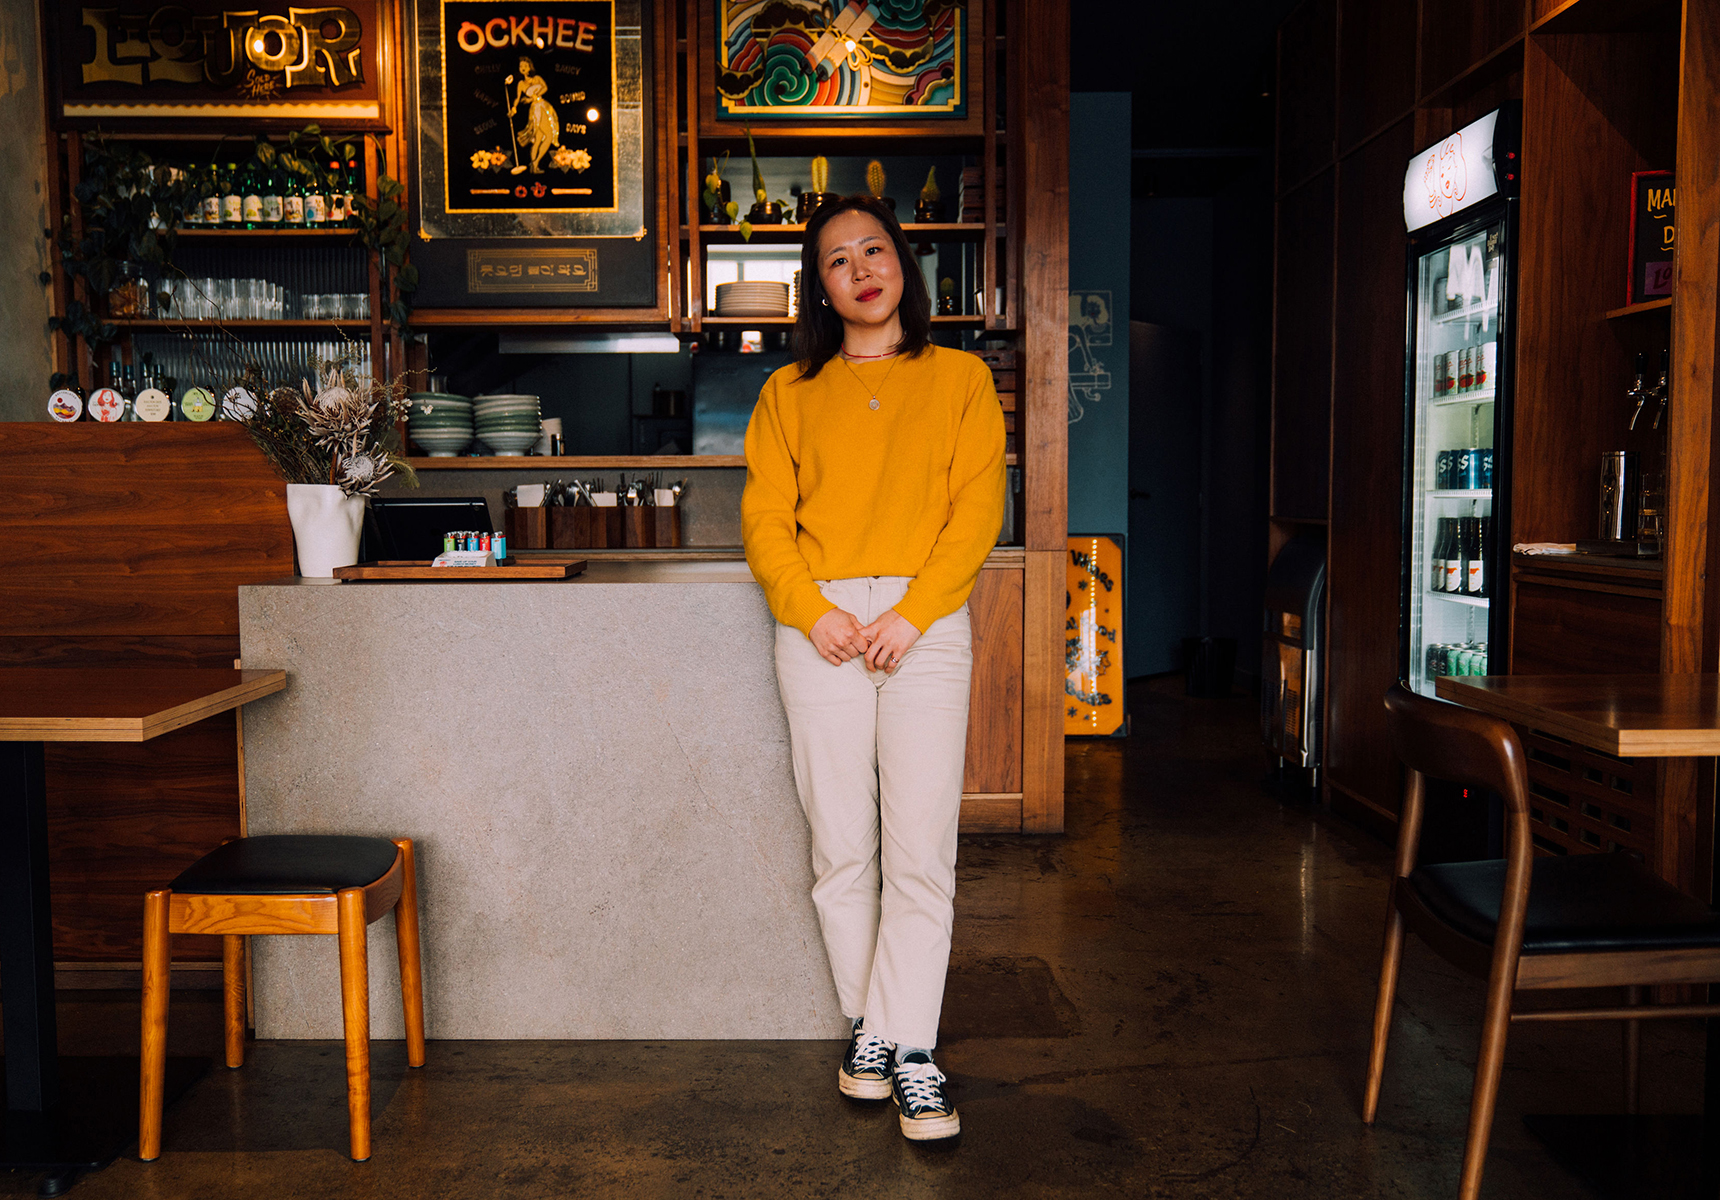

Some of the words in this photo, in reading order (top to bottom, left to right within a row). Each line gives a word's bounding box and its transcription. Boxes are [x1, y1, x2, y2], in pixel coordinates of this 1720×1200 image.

[457, 15, 598, 53] OCKHEE
[565, 122, 588, 136] DAYS
[1070, 549, 1114, 592] Wines
